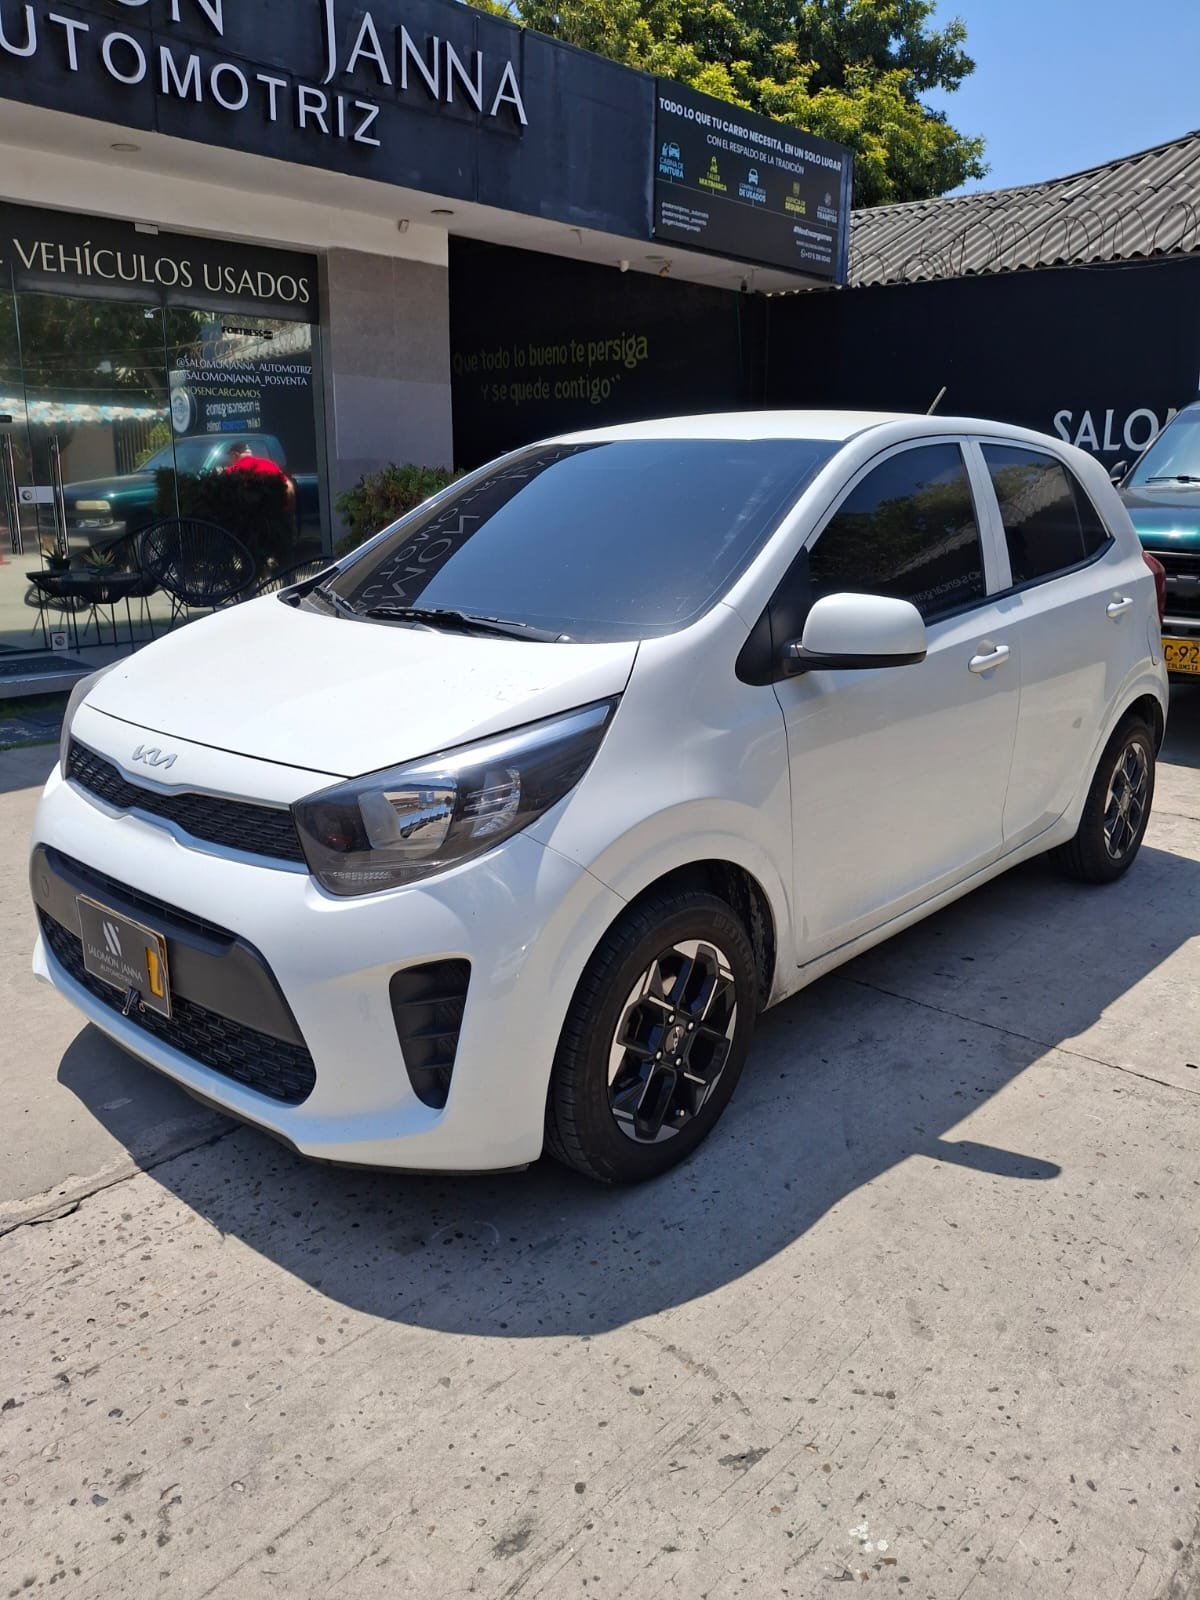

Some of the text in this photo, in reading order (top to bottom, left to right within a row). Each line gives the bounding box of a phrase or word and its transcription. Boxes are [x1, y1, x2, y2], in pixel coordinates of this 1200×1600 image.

[322, 0, 529, 126] JANNA
[659, 97, 842, 172] TODO LO QUE TU CARRO NECESITA, EN UN SOLO LUGAR
[707, 134, 805, 175] CON EL RESPALDO DE LA TRADICIÓN
[659, 164, 684, 178] PINTURA
[12, 239, 310, 303] VEHÍCULOS USADOS
[453, 331, 649, 376] Que todo lo bueno te persiga
[492, 383, 507, 400] se
[510, 376, 550, 406] quede
[1053, 408, 1178, 451] SALO
